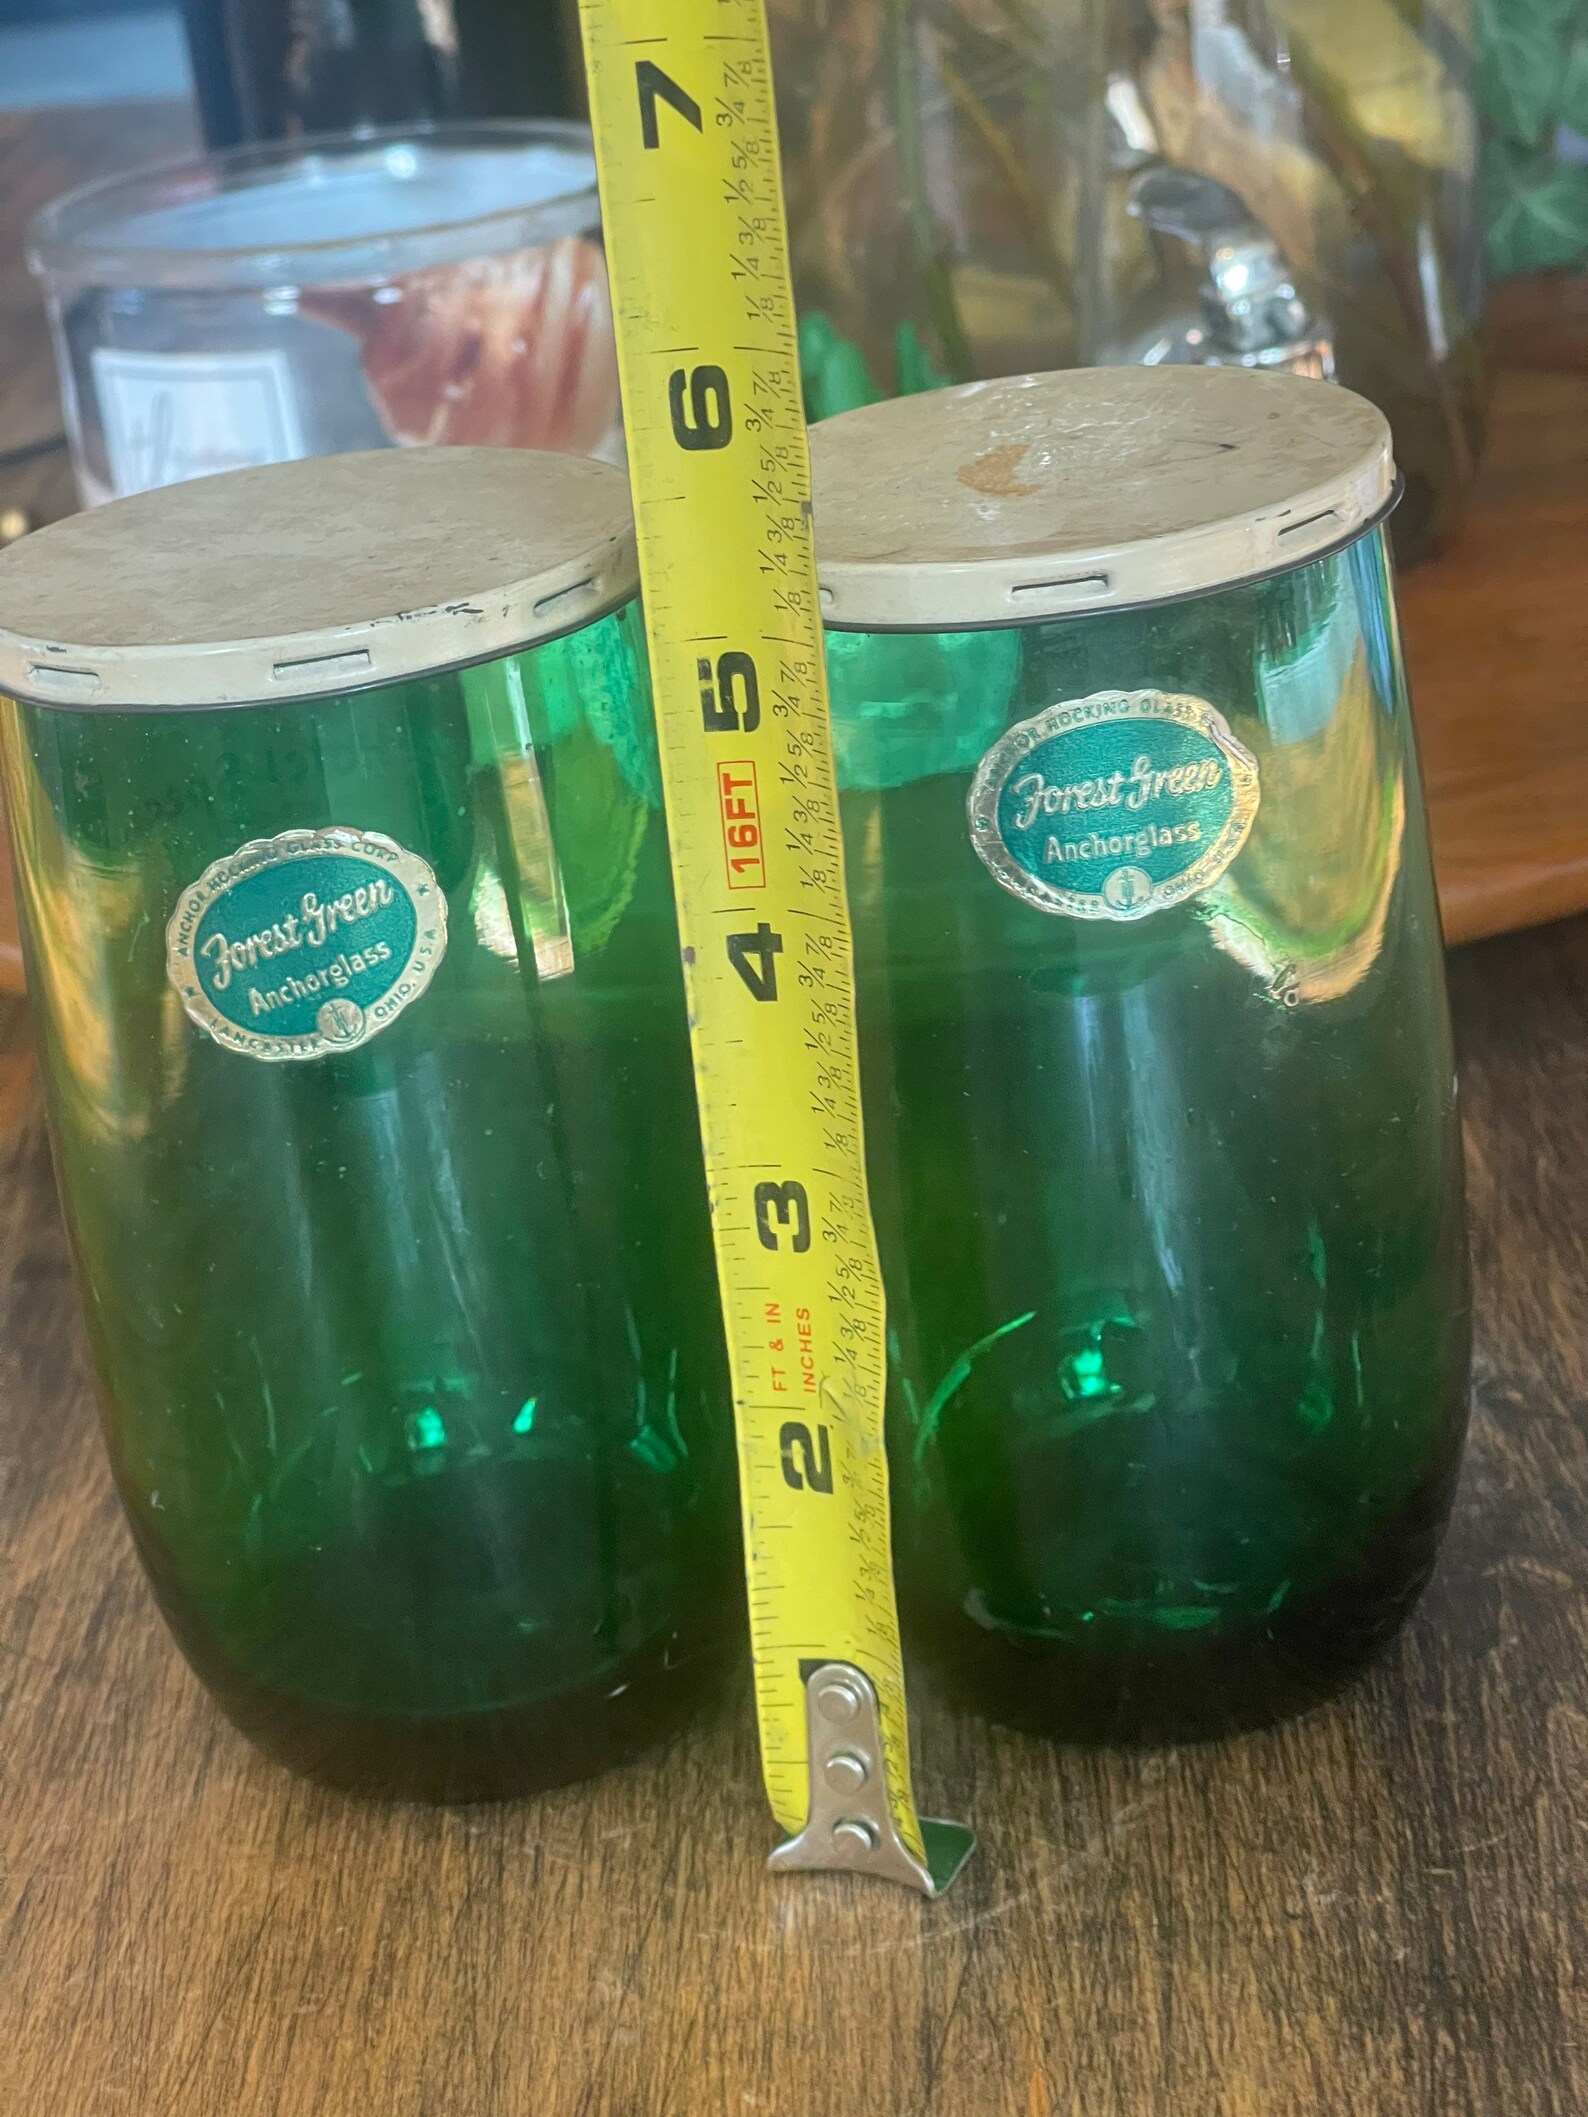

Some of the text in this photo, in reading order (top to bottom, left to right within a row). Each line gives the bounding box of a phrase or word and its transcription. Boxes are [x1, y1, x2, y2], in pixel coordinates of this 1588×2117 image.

[635, 60, 703, 149] 7
[668, 364, 733, 451] 6
[697, 651, 761, 733] 5
[722, 772, 760, 874] 16FT
[1012, 755, 1222, 831] Forest Green
[206, 847, 279, 892] HOCG
[1042, 821, 1201, 863] Anchorglass
[200, 880, 394, 991] Forest Green
[726, 922, 784, 1002] 4
[249, 941, 393, 1017] Anchorglass
[753, 1180, 811, 1253] 3
[796, 1307, 817, 1394] INCHES
[779, 1421, 834, 1495] 2
